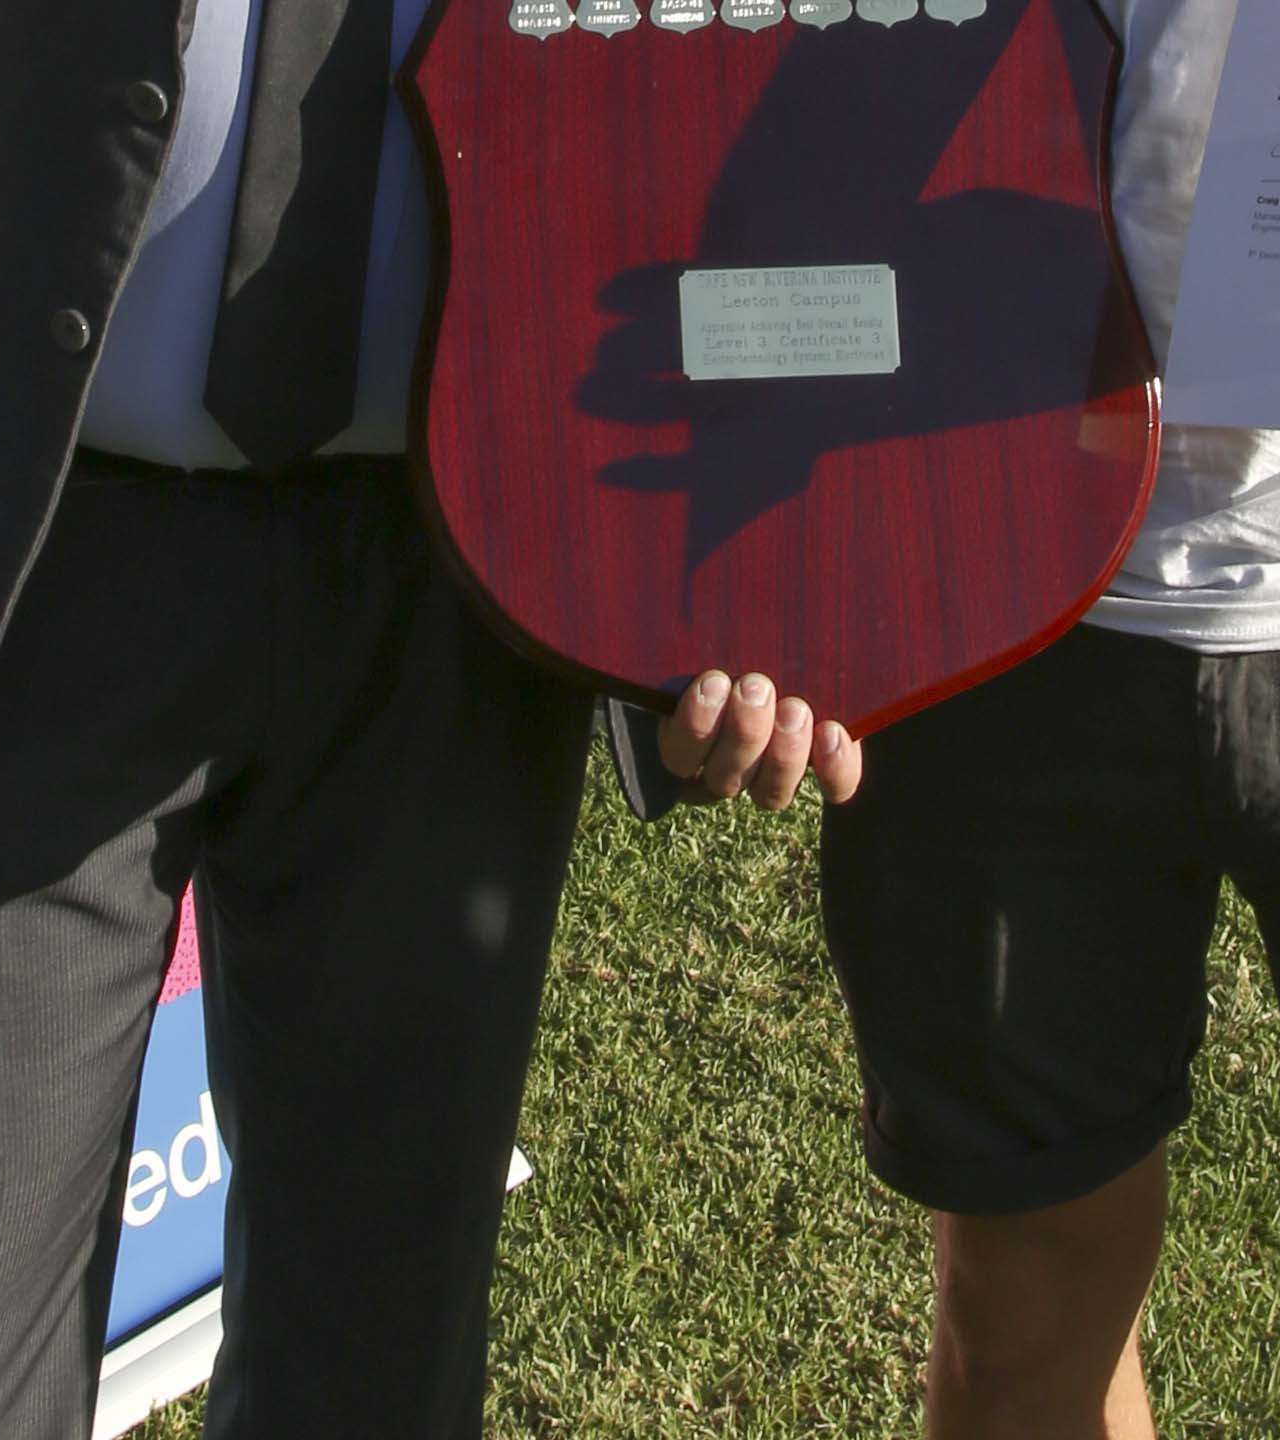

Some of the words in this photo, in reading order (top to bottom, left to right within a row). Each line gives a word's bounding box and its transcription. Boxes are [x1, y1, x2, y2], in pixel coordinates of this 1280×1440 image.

[1256, 196, 1279, 206] Craig
[722, 294, 780, 308] Leeton
[789, 292, 862, 309] Campus
[705, 336, 748, 349] Level
[757, 336, 767, 348] 3
[779, 333, 862, 347] Certificate
[872, 332, 881, 345] 3
